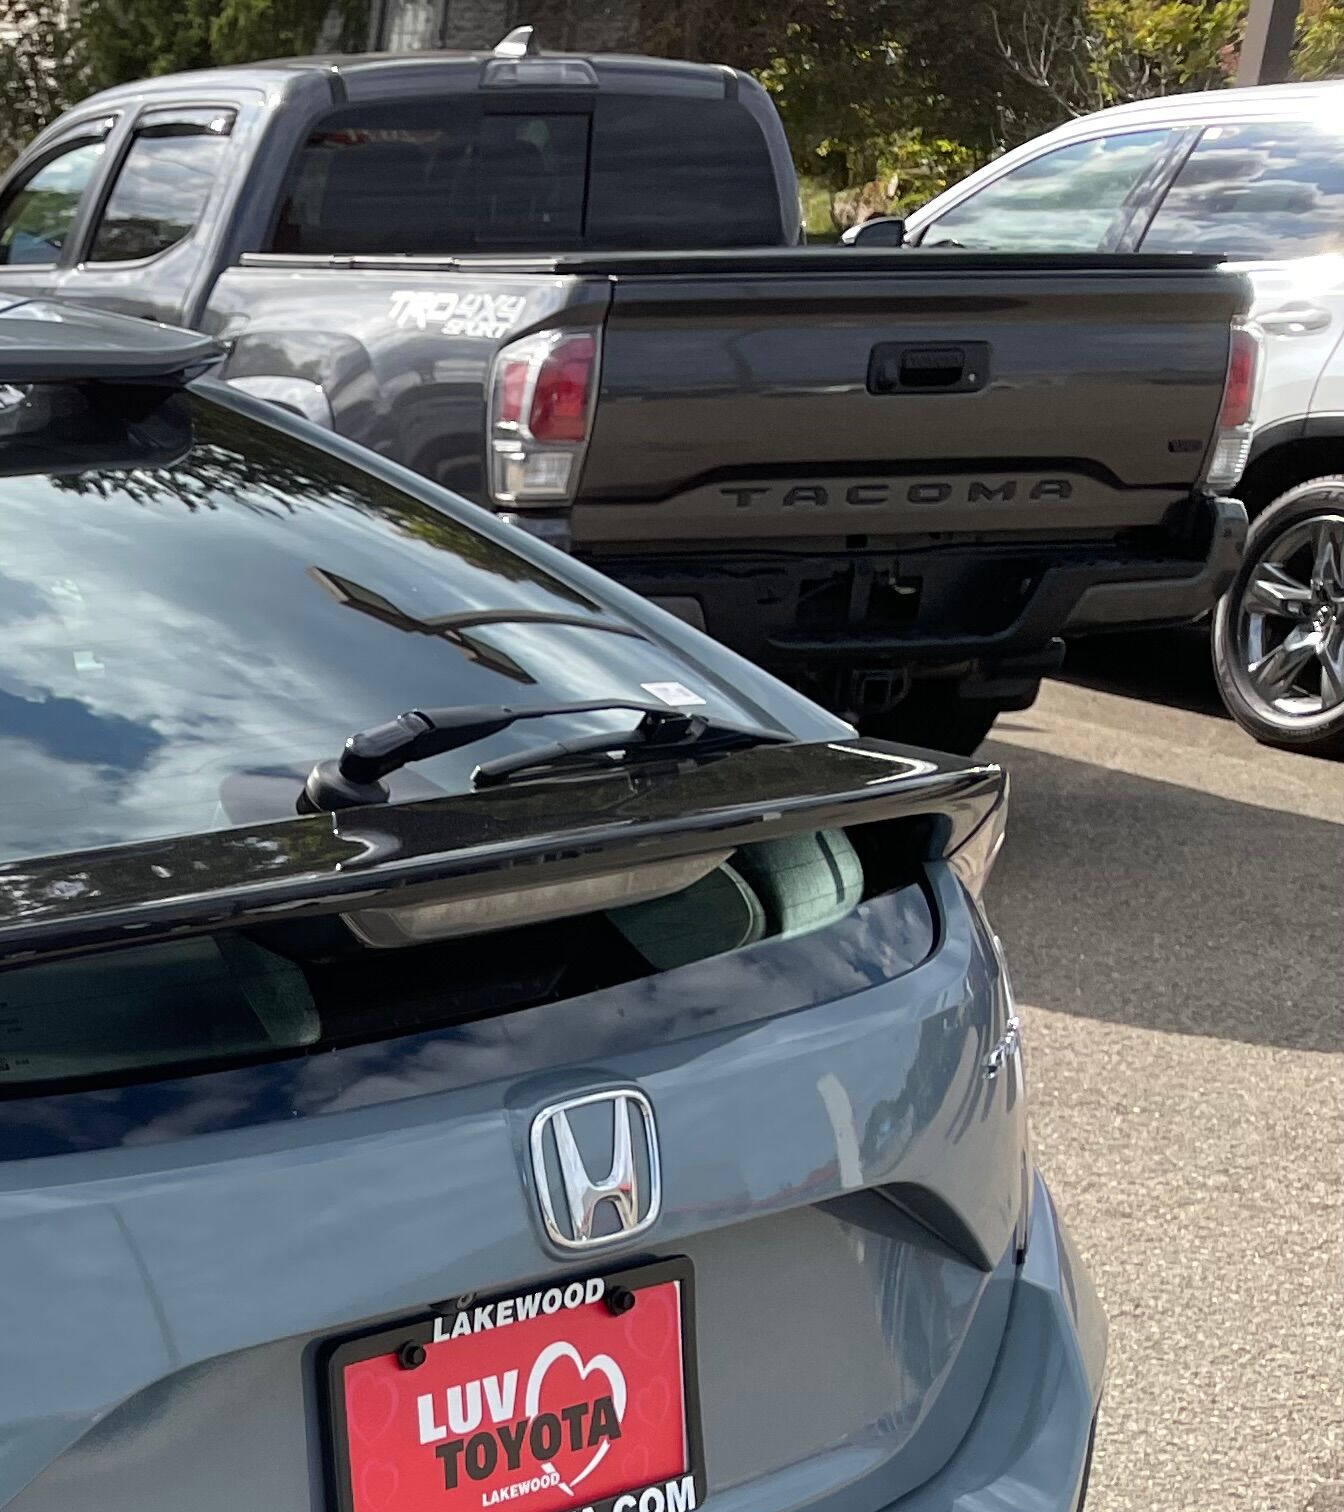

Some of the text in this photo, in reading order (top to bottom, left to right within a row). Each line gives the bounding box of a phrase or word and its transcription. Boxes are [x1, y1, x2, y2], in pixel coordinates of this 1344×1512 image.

[389, 290, 459, 331] TRD
[441, 319, 513, 339] SPORT
[719, 480, 1073, 508] TACOMA
[433, 1277, 605, 1344] LAKEWOOD
[417, 1369, 519, 1445] LUV
[435, 1395, 622, 1490] TOYOTA
[481, 1472, 561, 1507] LAKEWOOD
